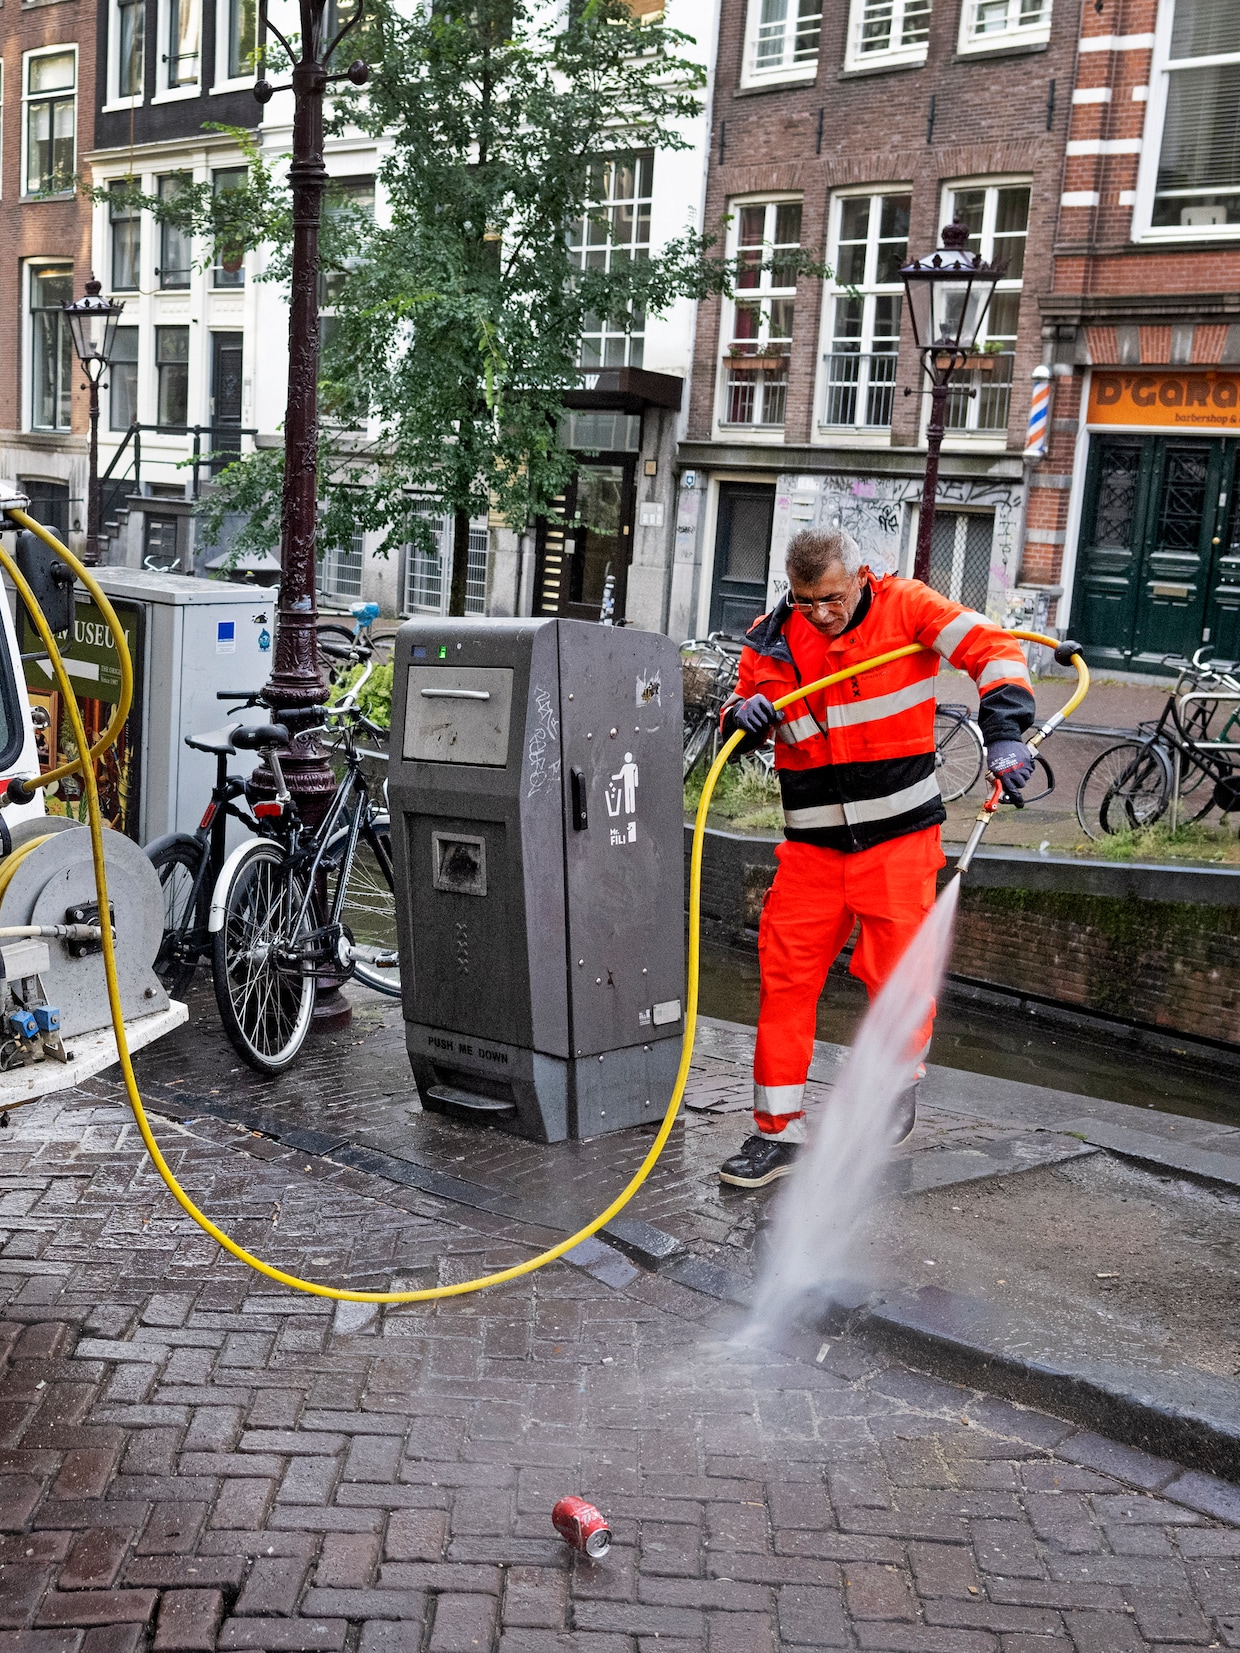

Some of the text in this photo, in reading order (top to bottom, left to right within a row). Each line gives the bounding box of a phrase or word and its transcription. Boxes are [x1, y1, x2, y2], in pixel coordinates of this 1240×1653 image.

[1175, 413, 1237, 425] barbershop &
[57, 618, 130, 653] USEU
[610, 834, 626, 846] FILI
[428, 1036, 508, 1065] PUSH ME DOWN
